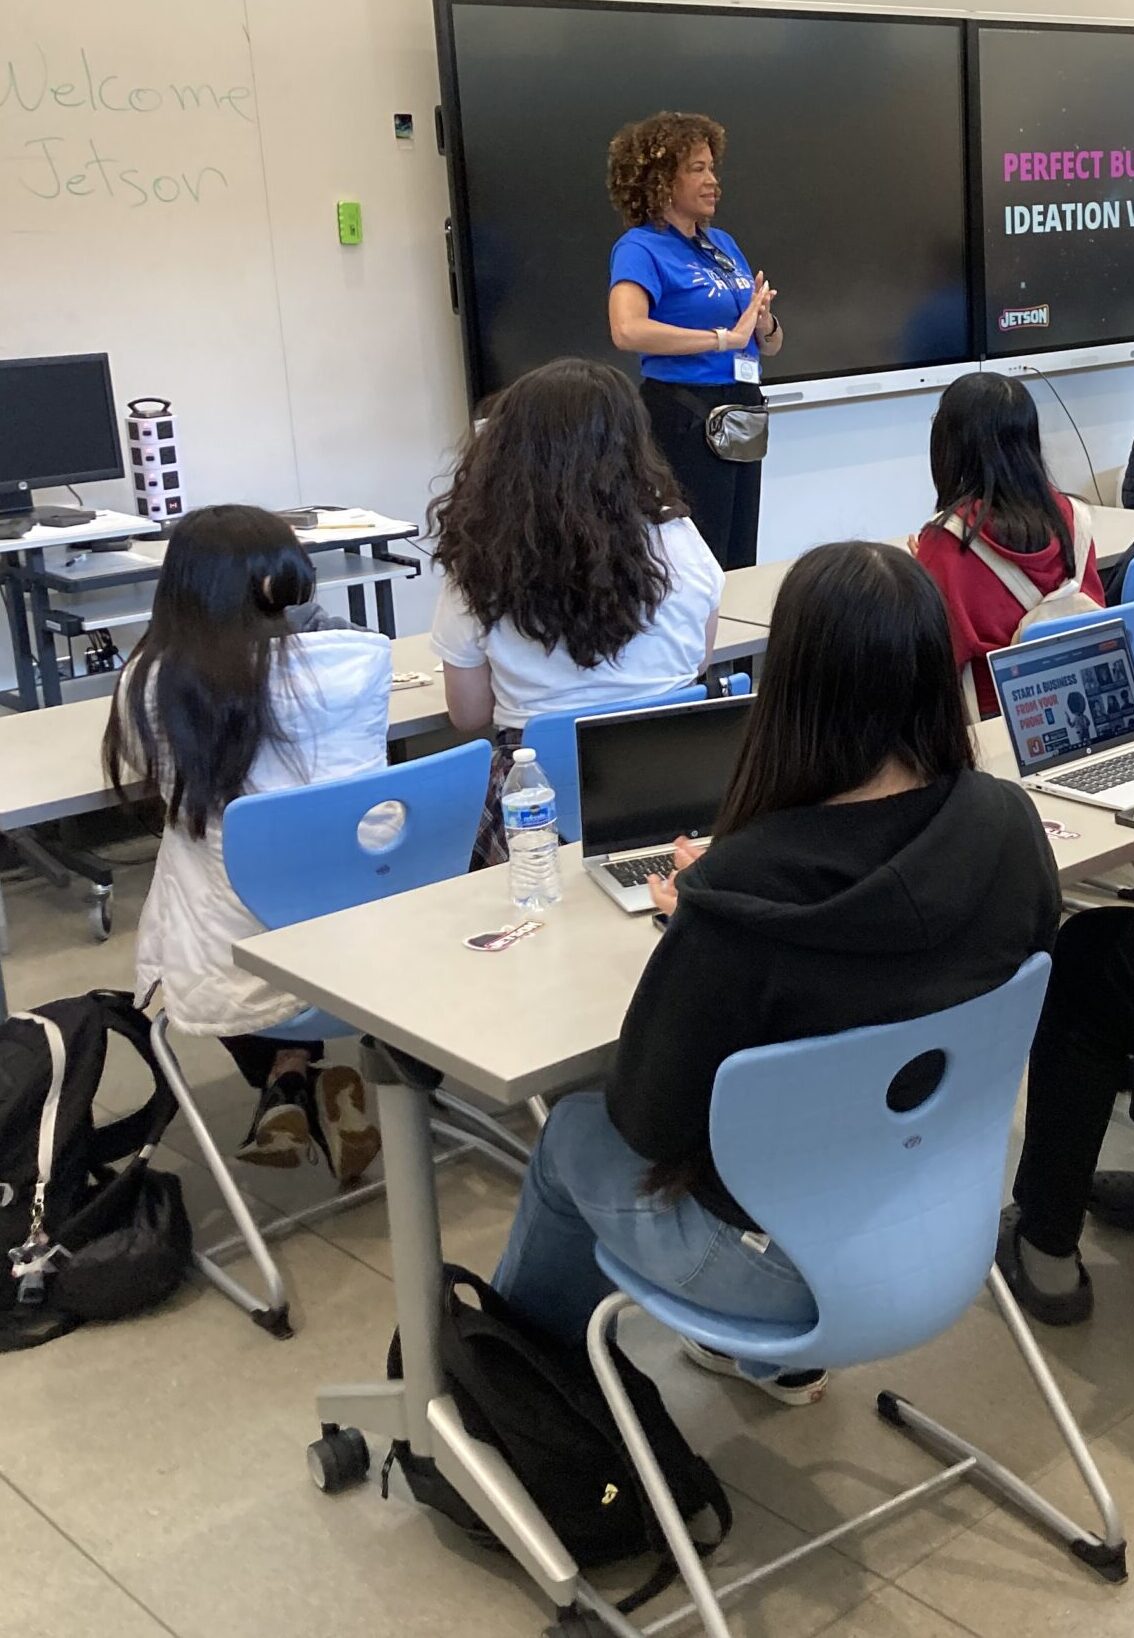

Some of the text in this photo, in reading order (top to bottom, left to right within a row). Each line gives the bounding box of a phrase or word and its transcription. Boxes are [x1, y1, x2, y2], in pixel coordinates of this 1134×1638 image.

[0, 43, 255, 124] Welcome
[18, 136, 229, 208] Jetson
[1003, 150, 1103, 182] PERFECT
[1005, 201, 1120, 235] IDEATION
[1000, 307, 1047, 328] JETSON
[1011, 673, 1078, 702] START A BUSINESS
